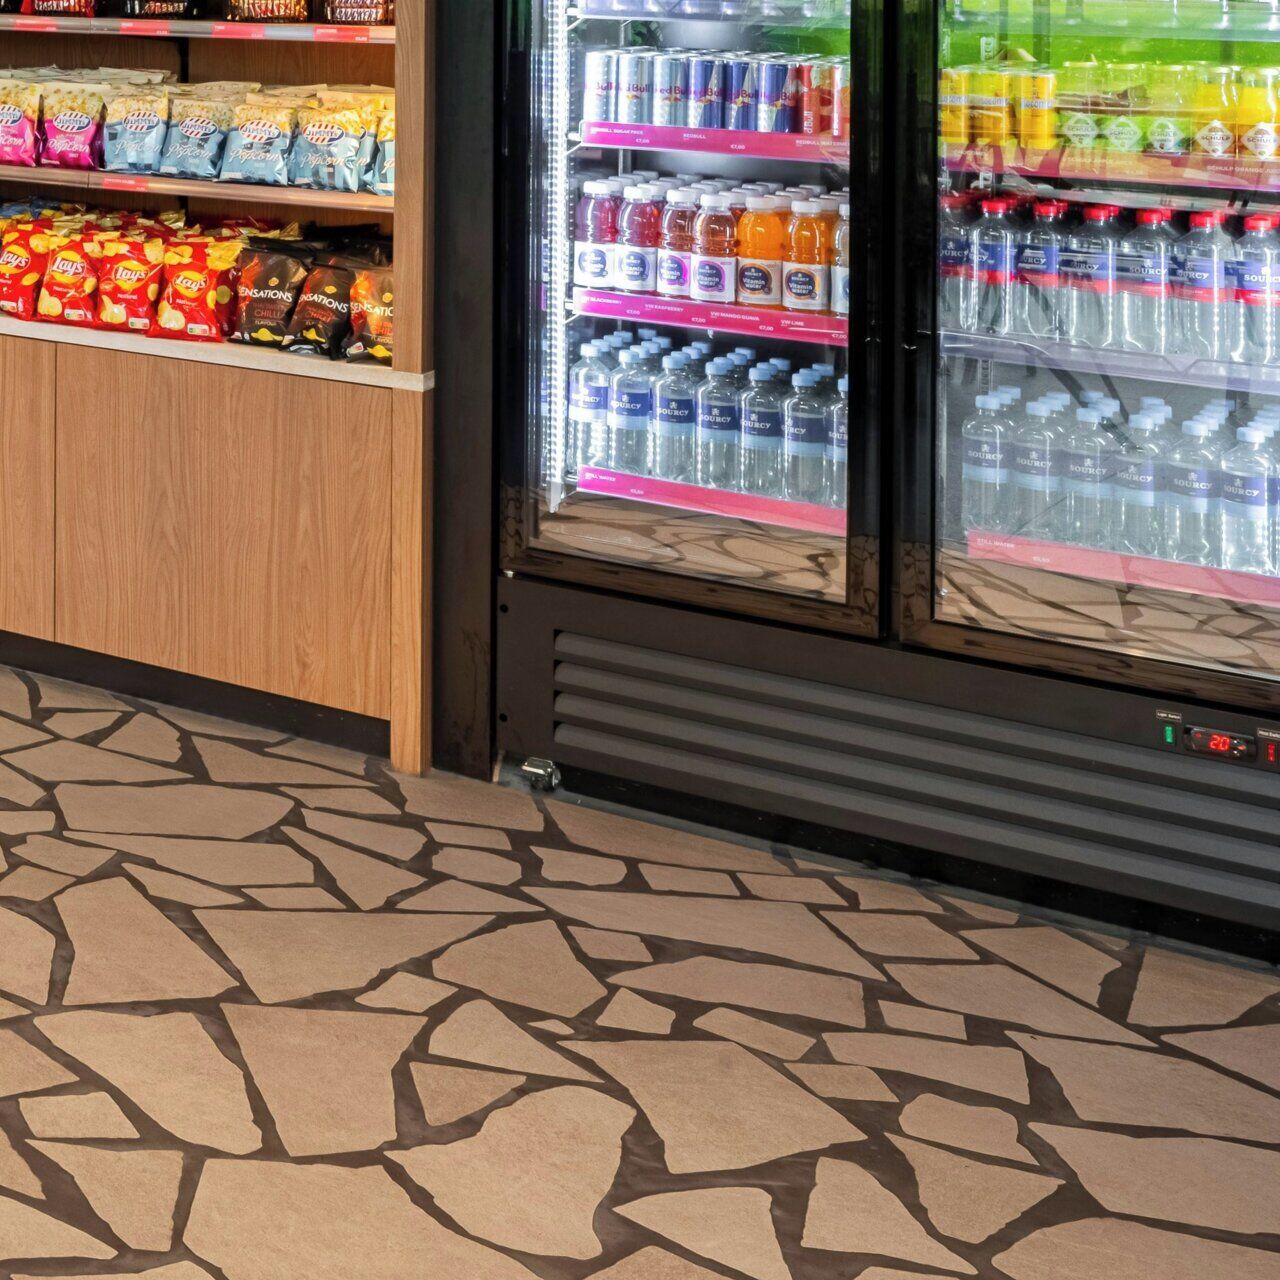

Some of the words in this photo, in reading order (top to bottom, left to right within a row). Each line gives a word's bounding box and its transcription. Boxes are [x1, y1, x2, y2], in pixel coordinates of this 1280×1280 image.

[48, 139, 90, 154] Popcorn
[168, 144, 213, 159] Popcorn
[230, 147, 280, 162] Popcorn
[0, 251, 28, 267] Lay's
[53, 256, 85, 272] Lay's
[115, 266, 147, 281] Lay's
[176, 276, 207, 290] Lay's
[299, 293, 348, 313] NSATIONS
[654, 304, 684, 312] RASPBERRY
[255, 310, 280, 318] CHILLI
[658, 408, 688, 416] SOURCY
[700, 414, 731, 422] SOURCY
[968, 451, 1003, 461] SOURCY
[1016, 458, 1052, 468] SOURCY
[1070, 465, 1107, 475] SOURCY
[1174, 479, 1212, 490] SOURCY
